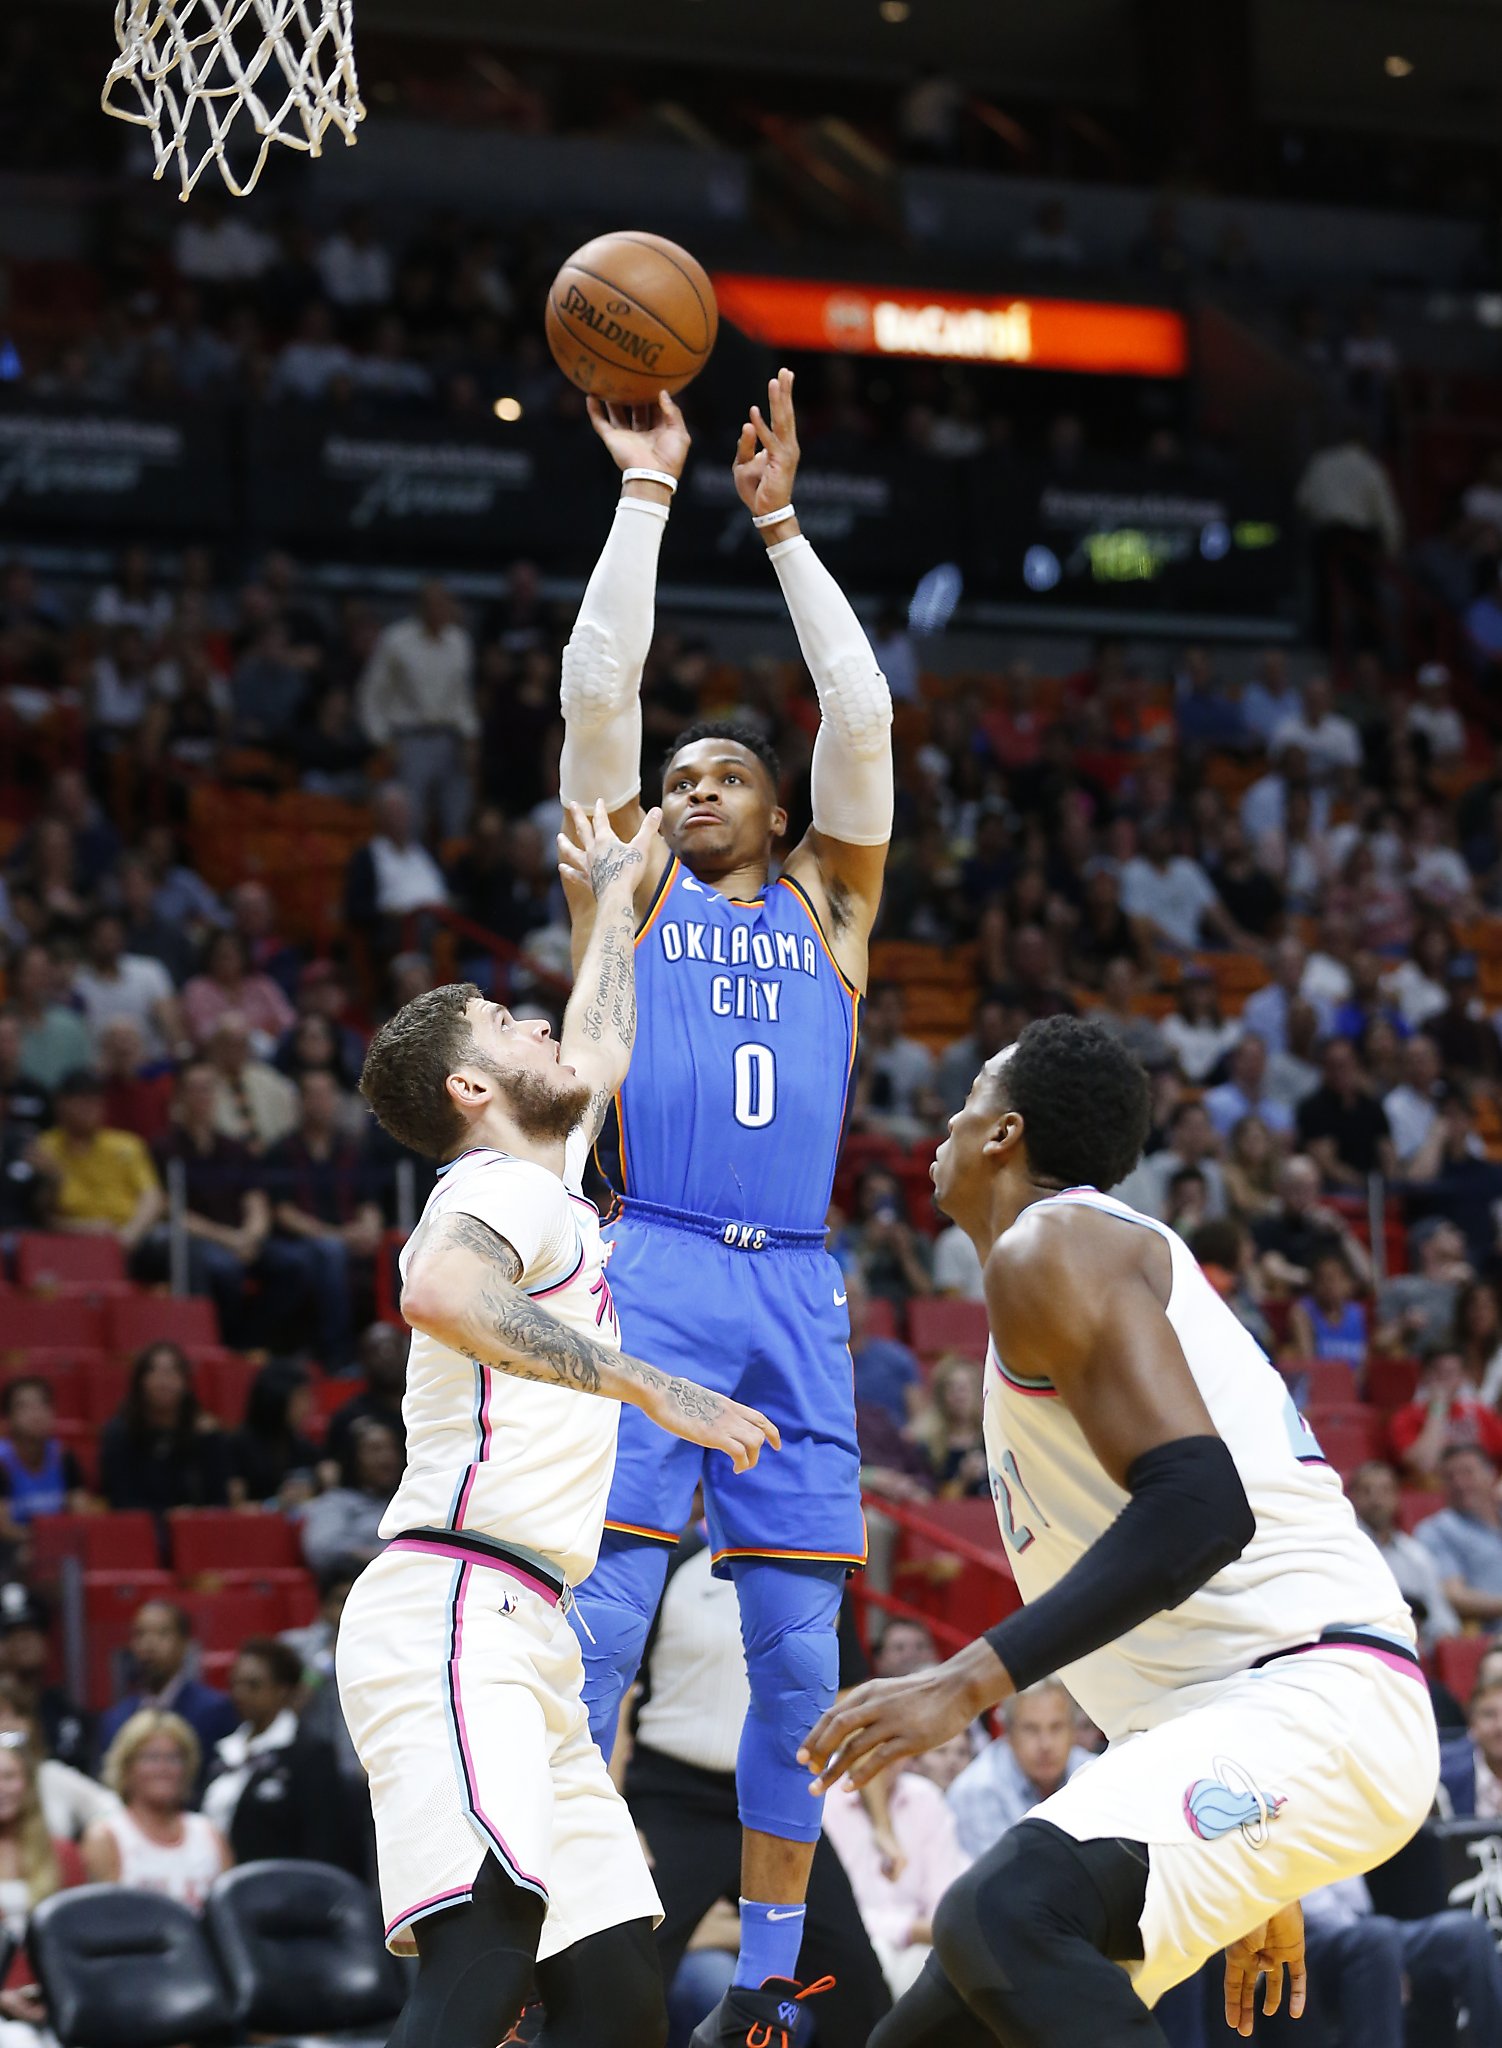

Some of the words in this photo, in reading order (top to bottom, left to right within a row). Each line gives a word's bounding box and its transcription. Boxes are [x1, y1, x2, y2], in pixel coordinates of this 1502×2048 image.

[560, 284, 665, 370] SPALDING
[660, 919, 818, 981] OKLAOMA
[710, 973, 783, 1024] CITY
[732, 1041, 778, 1130] 0
[988, 1448, 1051, 1555] 21
